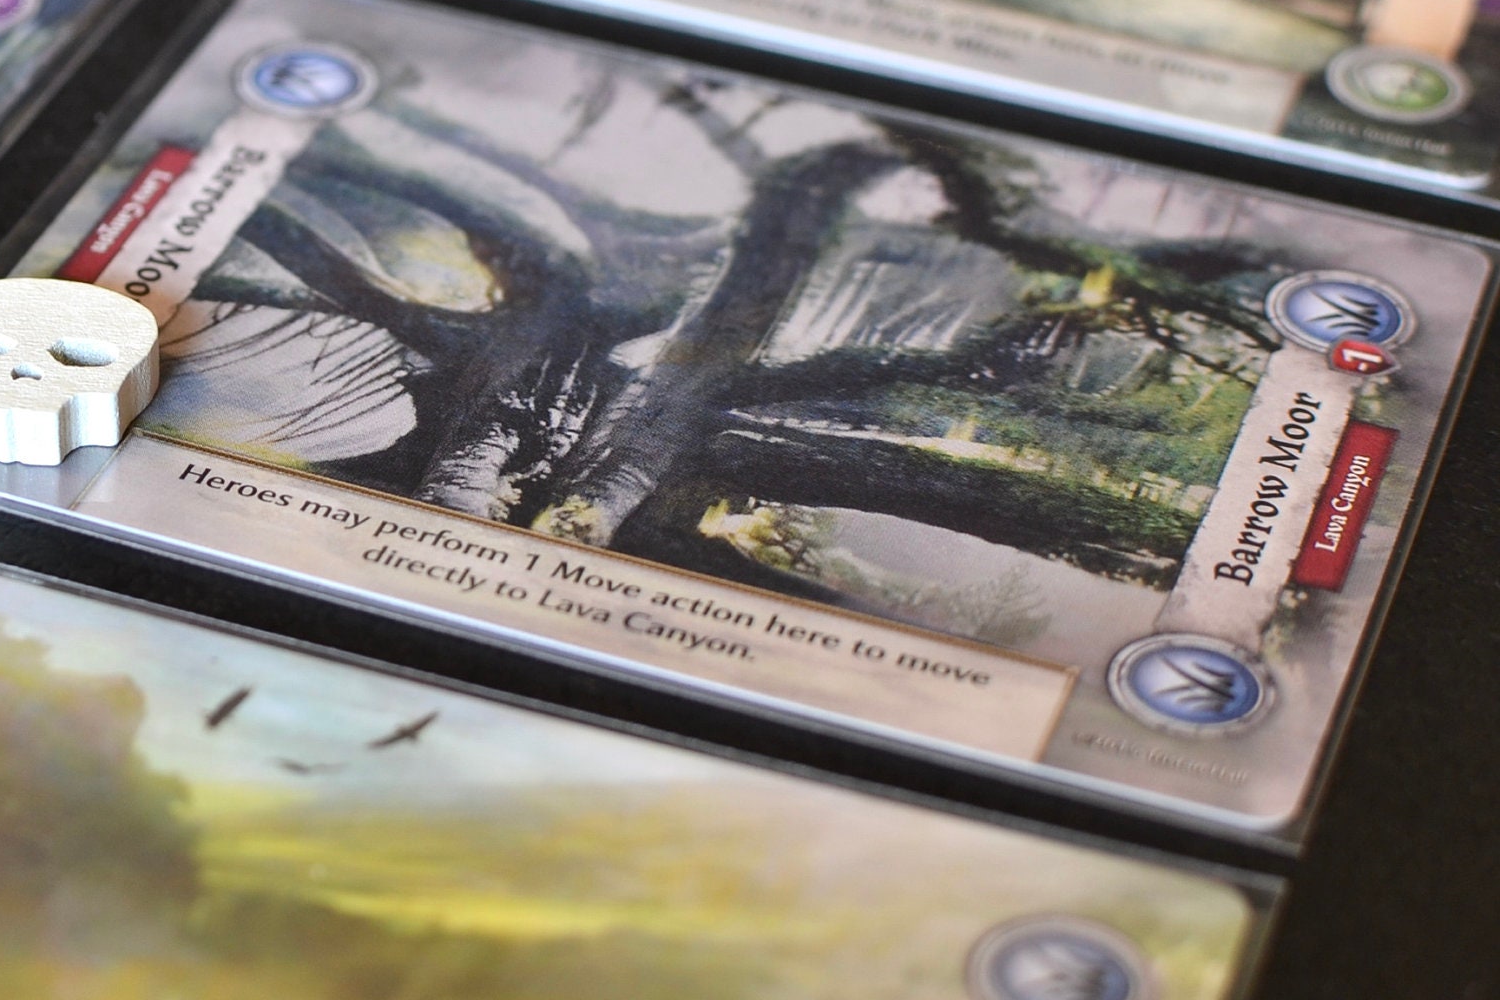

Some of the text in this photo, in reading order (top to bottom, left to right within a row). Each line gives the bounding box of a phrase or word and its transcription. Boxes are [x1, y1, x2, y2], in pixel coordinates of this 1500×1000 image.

[125, 147, 265, 302] Barrow Moo
[1214, 392, 1321, 586] Barrow Moor
[1315, 455, 1373, 552] Lava Canyon
[179, 463, 991, 688] Heroes may perform 1 Move action here to move
[363, 543, 757, 663] directly to Lava Canyon.
